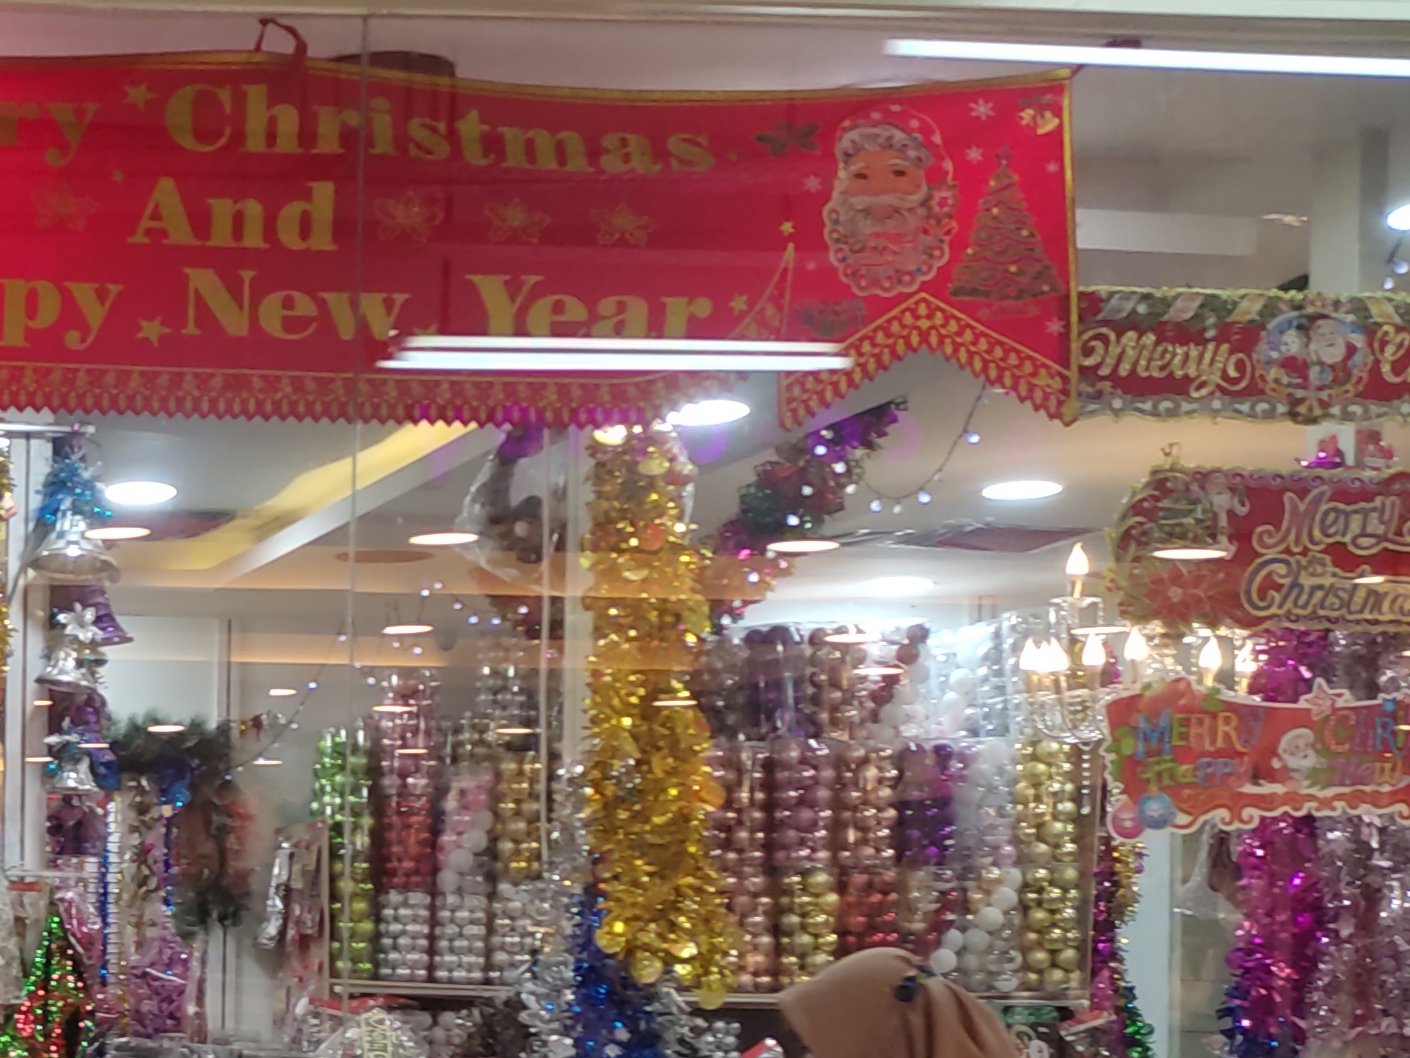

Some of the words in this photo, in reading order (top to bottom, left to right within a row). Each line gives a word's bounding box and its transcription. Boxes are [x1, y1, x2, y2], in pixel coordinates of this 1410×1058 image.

[164, 83, 718, 176] Christmas
[127, 175, 338, 252] And
[181, 267, 412, 342] New
[465, 274, 713, 340] Year
[1078, 326, 1252, 398] Merry
[1251, 485, 1410, 556] Merry
